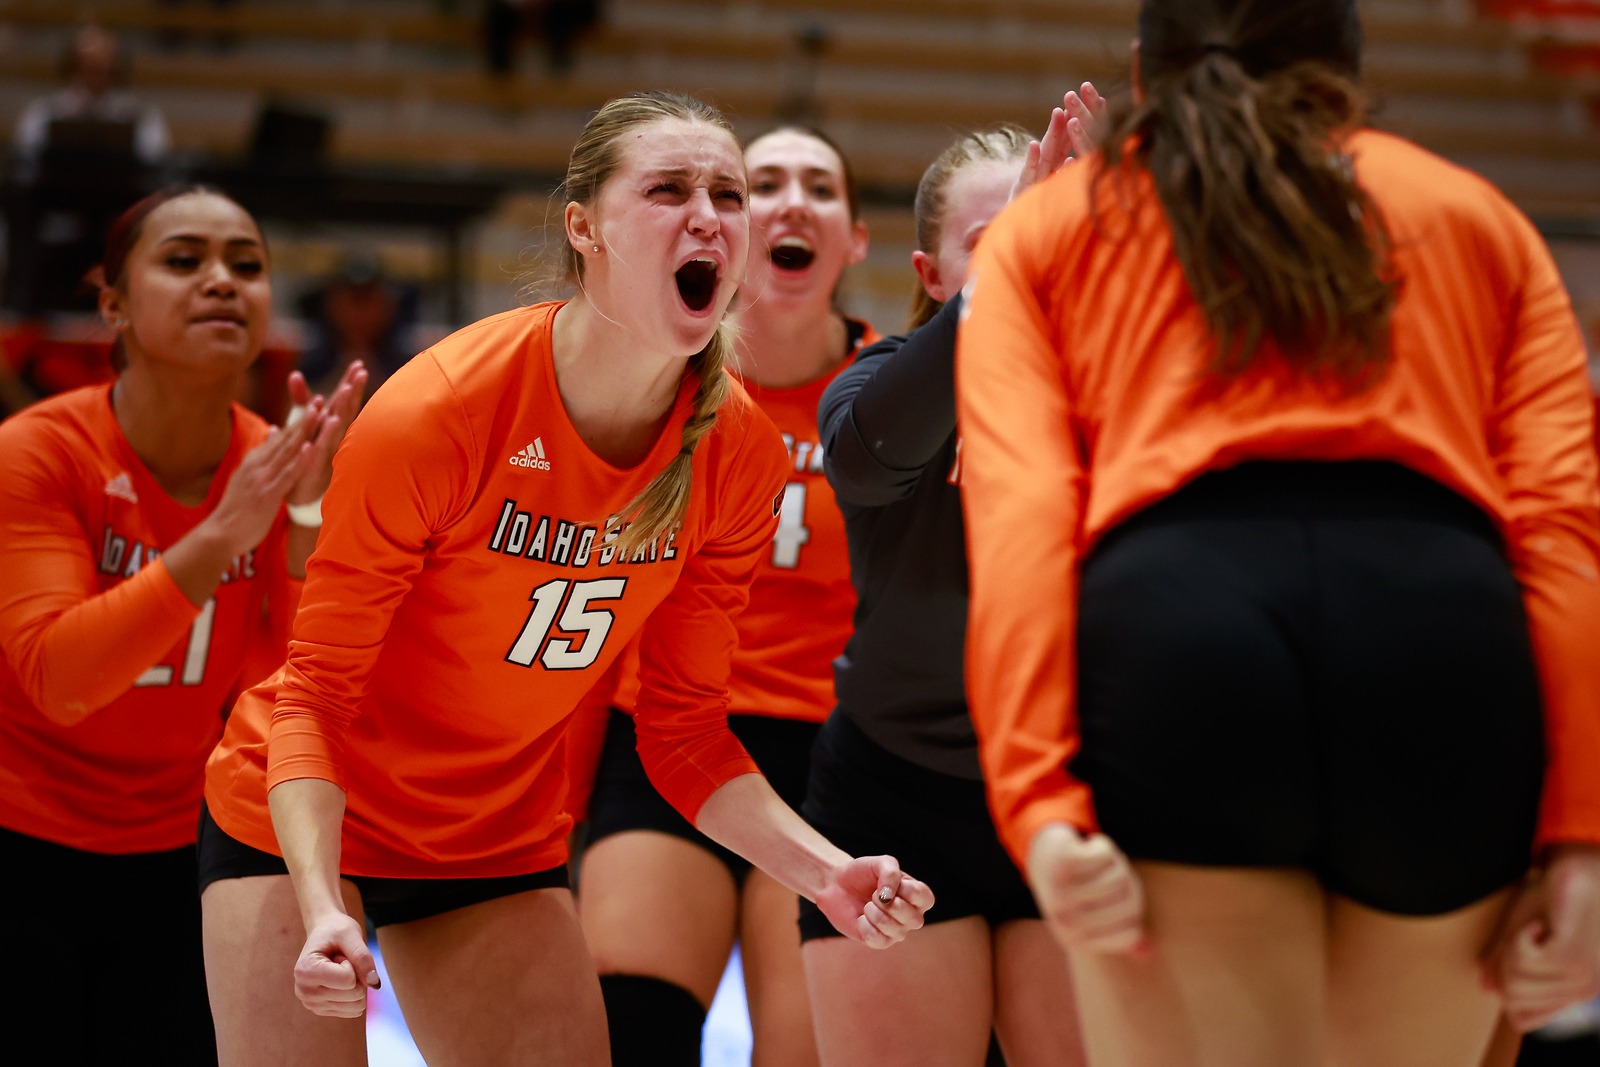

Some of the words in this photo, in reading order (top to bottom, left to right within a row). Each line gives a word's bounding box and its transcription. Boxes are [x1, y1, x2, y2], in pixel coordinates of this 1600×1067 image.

[509, 455, 551, 471] adidas
[488, 498, 597, 568] IDAHO
[132, 597, 216, 688] 1
[504, 576, 629, 670] 15
